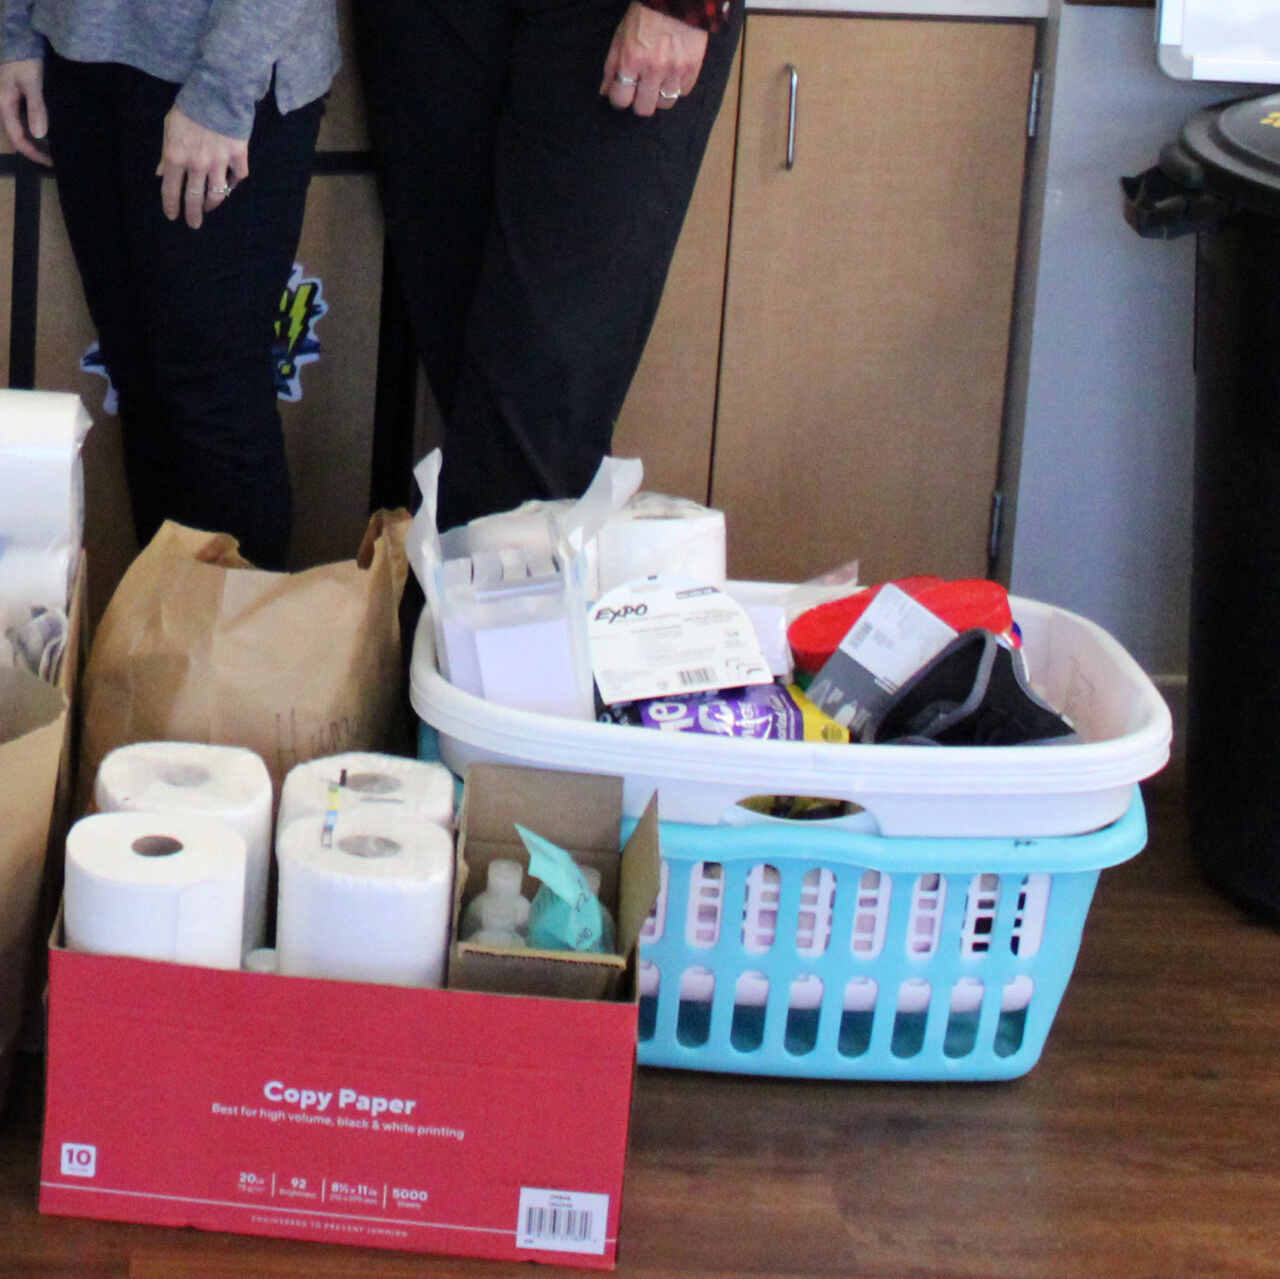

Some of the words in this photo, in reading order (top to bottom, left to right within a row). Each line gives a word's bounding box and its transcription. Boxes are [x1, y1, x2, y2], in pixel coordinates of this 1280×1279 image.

[594, 603, 648, 624] EXPO
[263, 1080, 333, 1110] Copy
[338, 1088, 417, 1116] Paper
[211, 1102, 238, 1115] Best
[240, 1104, 257, 1117] for
[259, 1106, 286, 1121] high
[288, 1111, 334, 1128] volume,
[336, 1115, 369, 1129] black
[371, 1119, 380, 1130] &
[382, 1121, 415, 1134] white
[417, 1125, 465, 1140] printing
[66, 1148, 91, 1165] 10
[291, 1177, 307, 1189] 92
[392, 1188, 428, 1201] 5000
